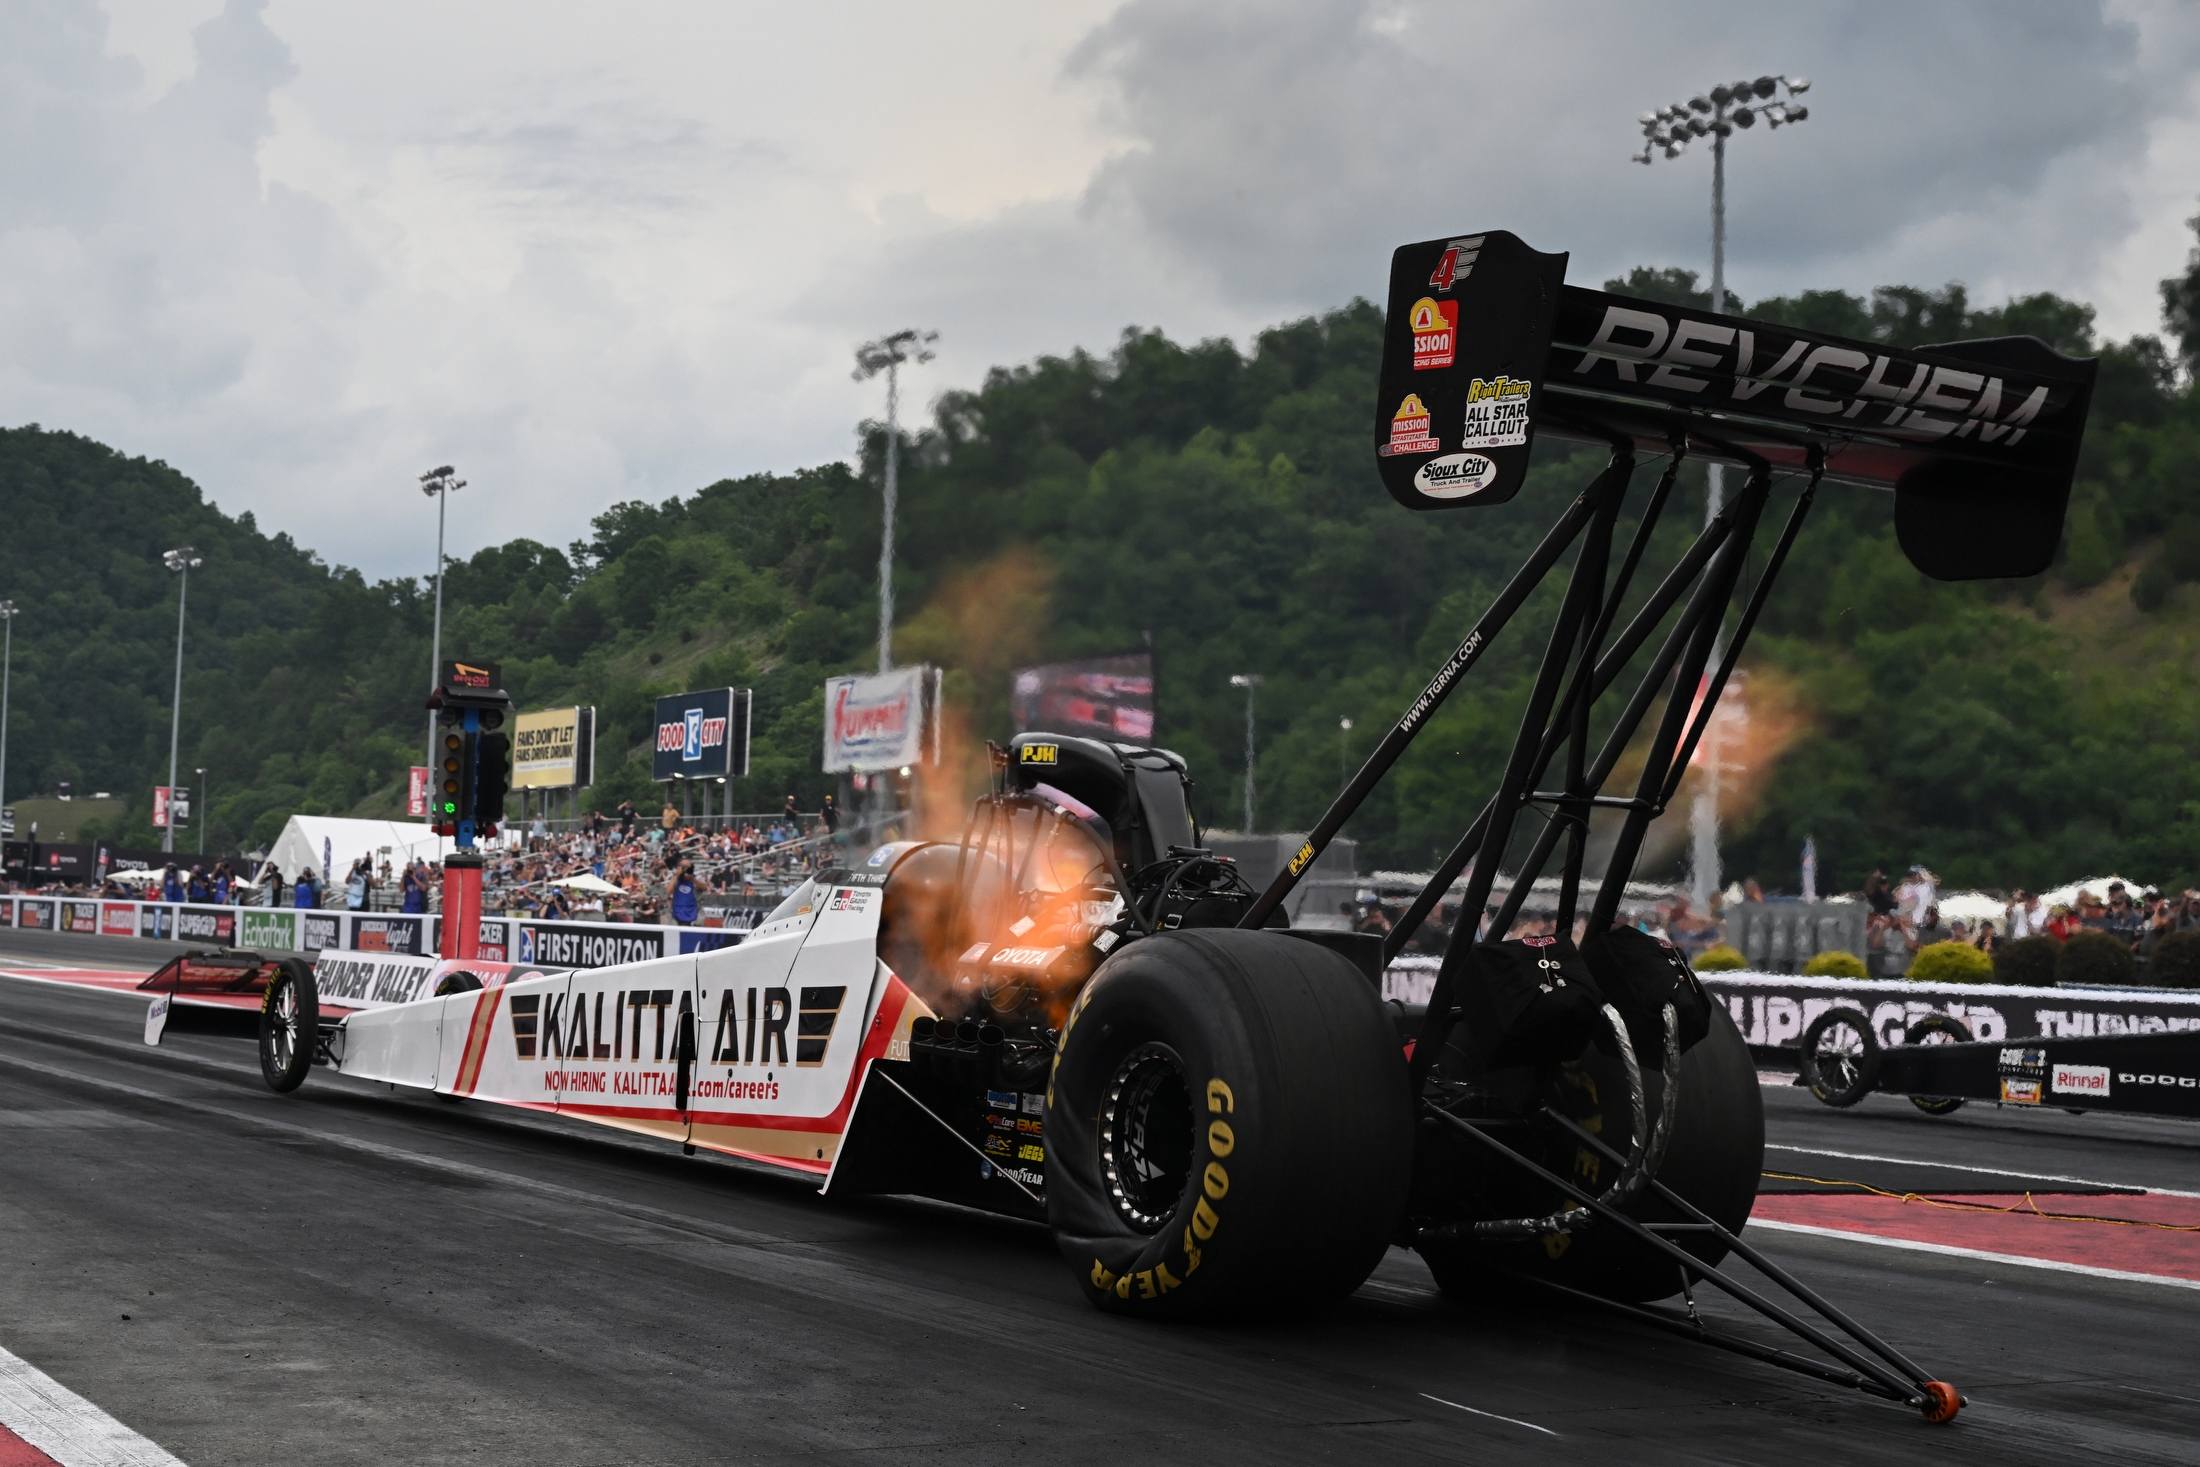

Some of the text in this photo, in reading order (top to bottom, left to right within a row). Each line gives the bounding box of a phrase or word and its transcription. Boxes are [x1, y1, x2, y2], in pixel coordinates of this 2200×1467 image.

[1430, 248, 1459, 291] 4
[1431, 356, 1453, 366] SERIES
[1574, 305, 2050, 446] REVCHEM
[1467, 403, 1526, 423] ALL STAR
[1392, 417, 1428, 433] MISSION
[1465, 419, 1525, 438] CALLOUT
[1393, 440, 1437, 453] CHALLENGE
[1422, 457, 1490, 479] Sioux City
[1400, 630, 1483, 733] WWW.TGRNA.COM
[517, 725, 575, 747] FANS DON'T LET
[657, 717, 727, 751] FOOD CITY
[515, 744, 574, 763] FANS DRIVE DRUNK
[1022, 746, 1055, 762] PJH
[411, 800, 423, 813] 5
[115, 859, 149, 870] TOYOTA
[1289, 841, 1313, 875] PJH
[831, 897, 849, 911] GR
[244, 914, 292, 950] EchoPark
[305, 919, 336, 937] THUNDER
[385, 921, 414, 953] light
[481, 922, 504, 945] CKER
[537, 932, 658, 966] FIRST HORIZON
[991, 947, 1048, 966] OYOTA
[314, 958, 375, 1000] THUNDER
[370, 963, 433, 1003] VALLEY
[540, 986, 793, 1068] KALITTA AIR
[545, 1070, 779, 1101] NOW HIRING KALITTAA.com/careers
[2057, 1071, 2106, 1089] Rinnai
[2117, 1072, 2200, 1088] DODG
[1017, 1143, 1044, 1162] JEGS
